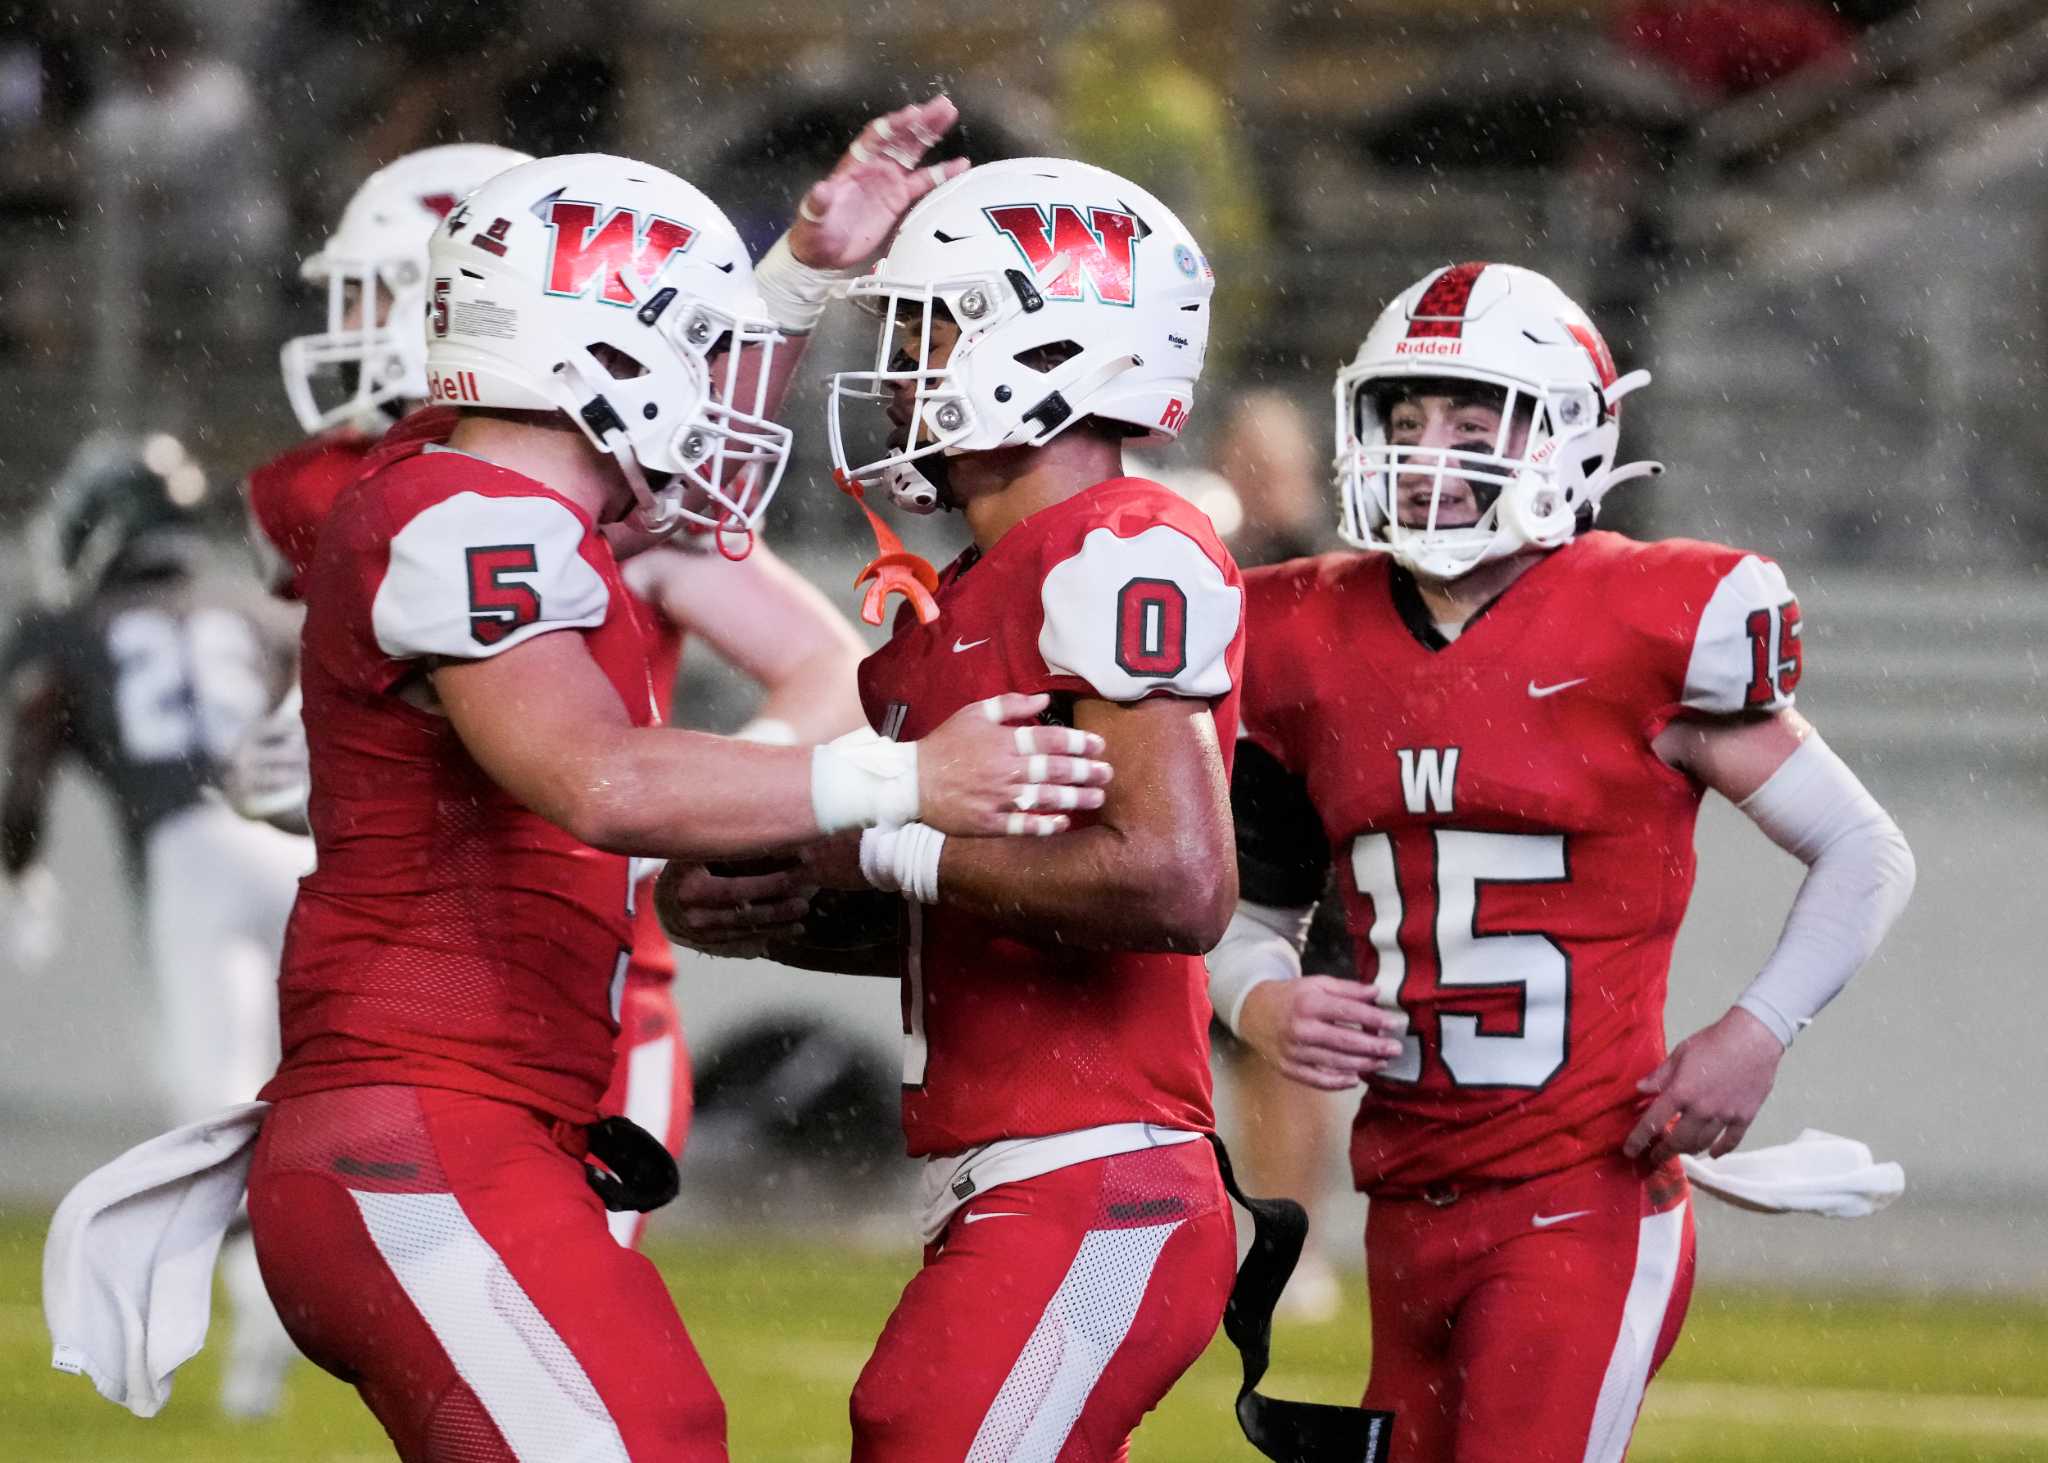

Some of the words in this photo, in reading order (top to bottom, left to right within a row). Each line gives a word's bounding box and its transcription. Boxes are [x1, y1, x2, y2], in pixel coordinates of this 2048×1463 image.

[544, 199, 700, 308] W
[981, 203, 1141, 308] W
[428, 369, 480, 401] dell
[1396, 341, 1462, 355] Riddell
[465, 544, 541, 646] 5
[1115, 576, 1187, 678] 0
[1744, 598, 1802, 703] 15
[1397, 748, 1461, 813] W
[1350, 829, 1571, 1092] 15
